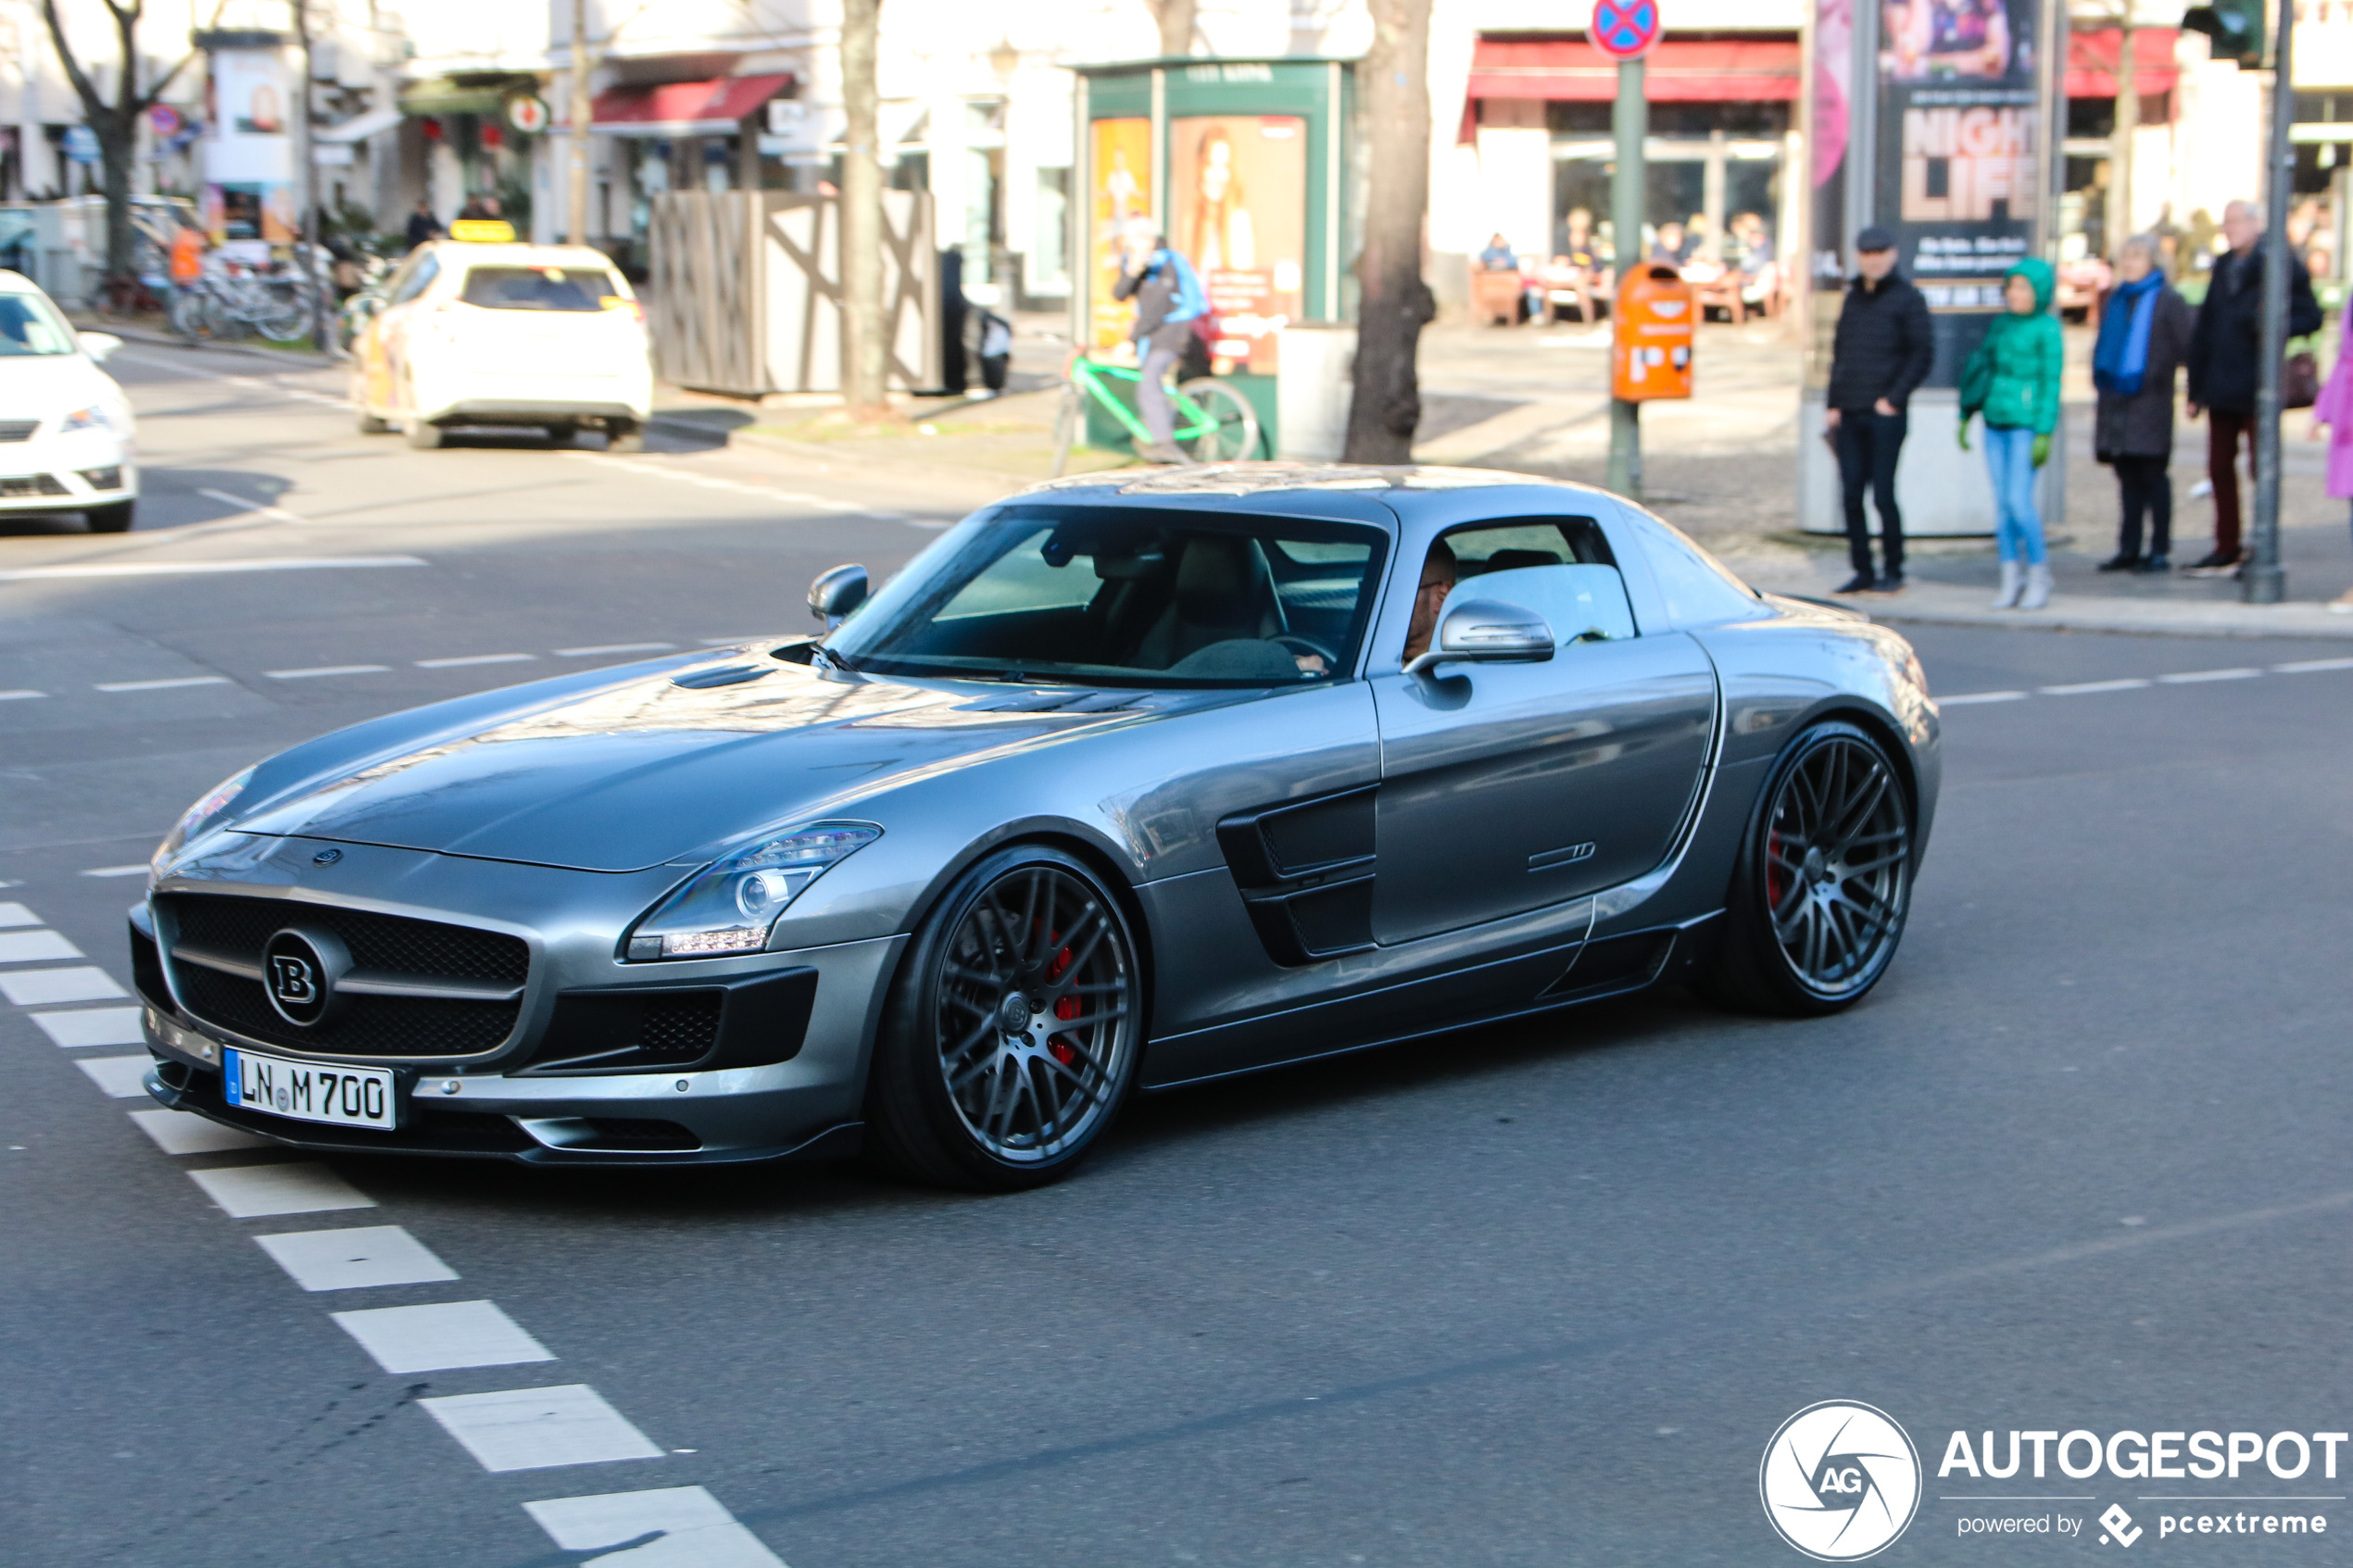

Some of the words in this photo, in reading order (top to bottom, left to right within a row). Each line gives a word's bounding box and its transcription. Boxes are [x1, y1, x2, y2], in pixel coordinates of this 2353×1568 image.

[1902, 157, 2040, 220] LIFE
[272, 955, 317, 1004] B
[241, 1059, 274, 1106] LN
